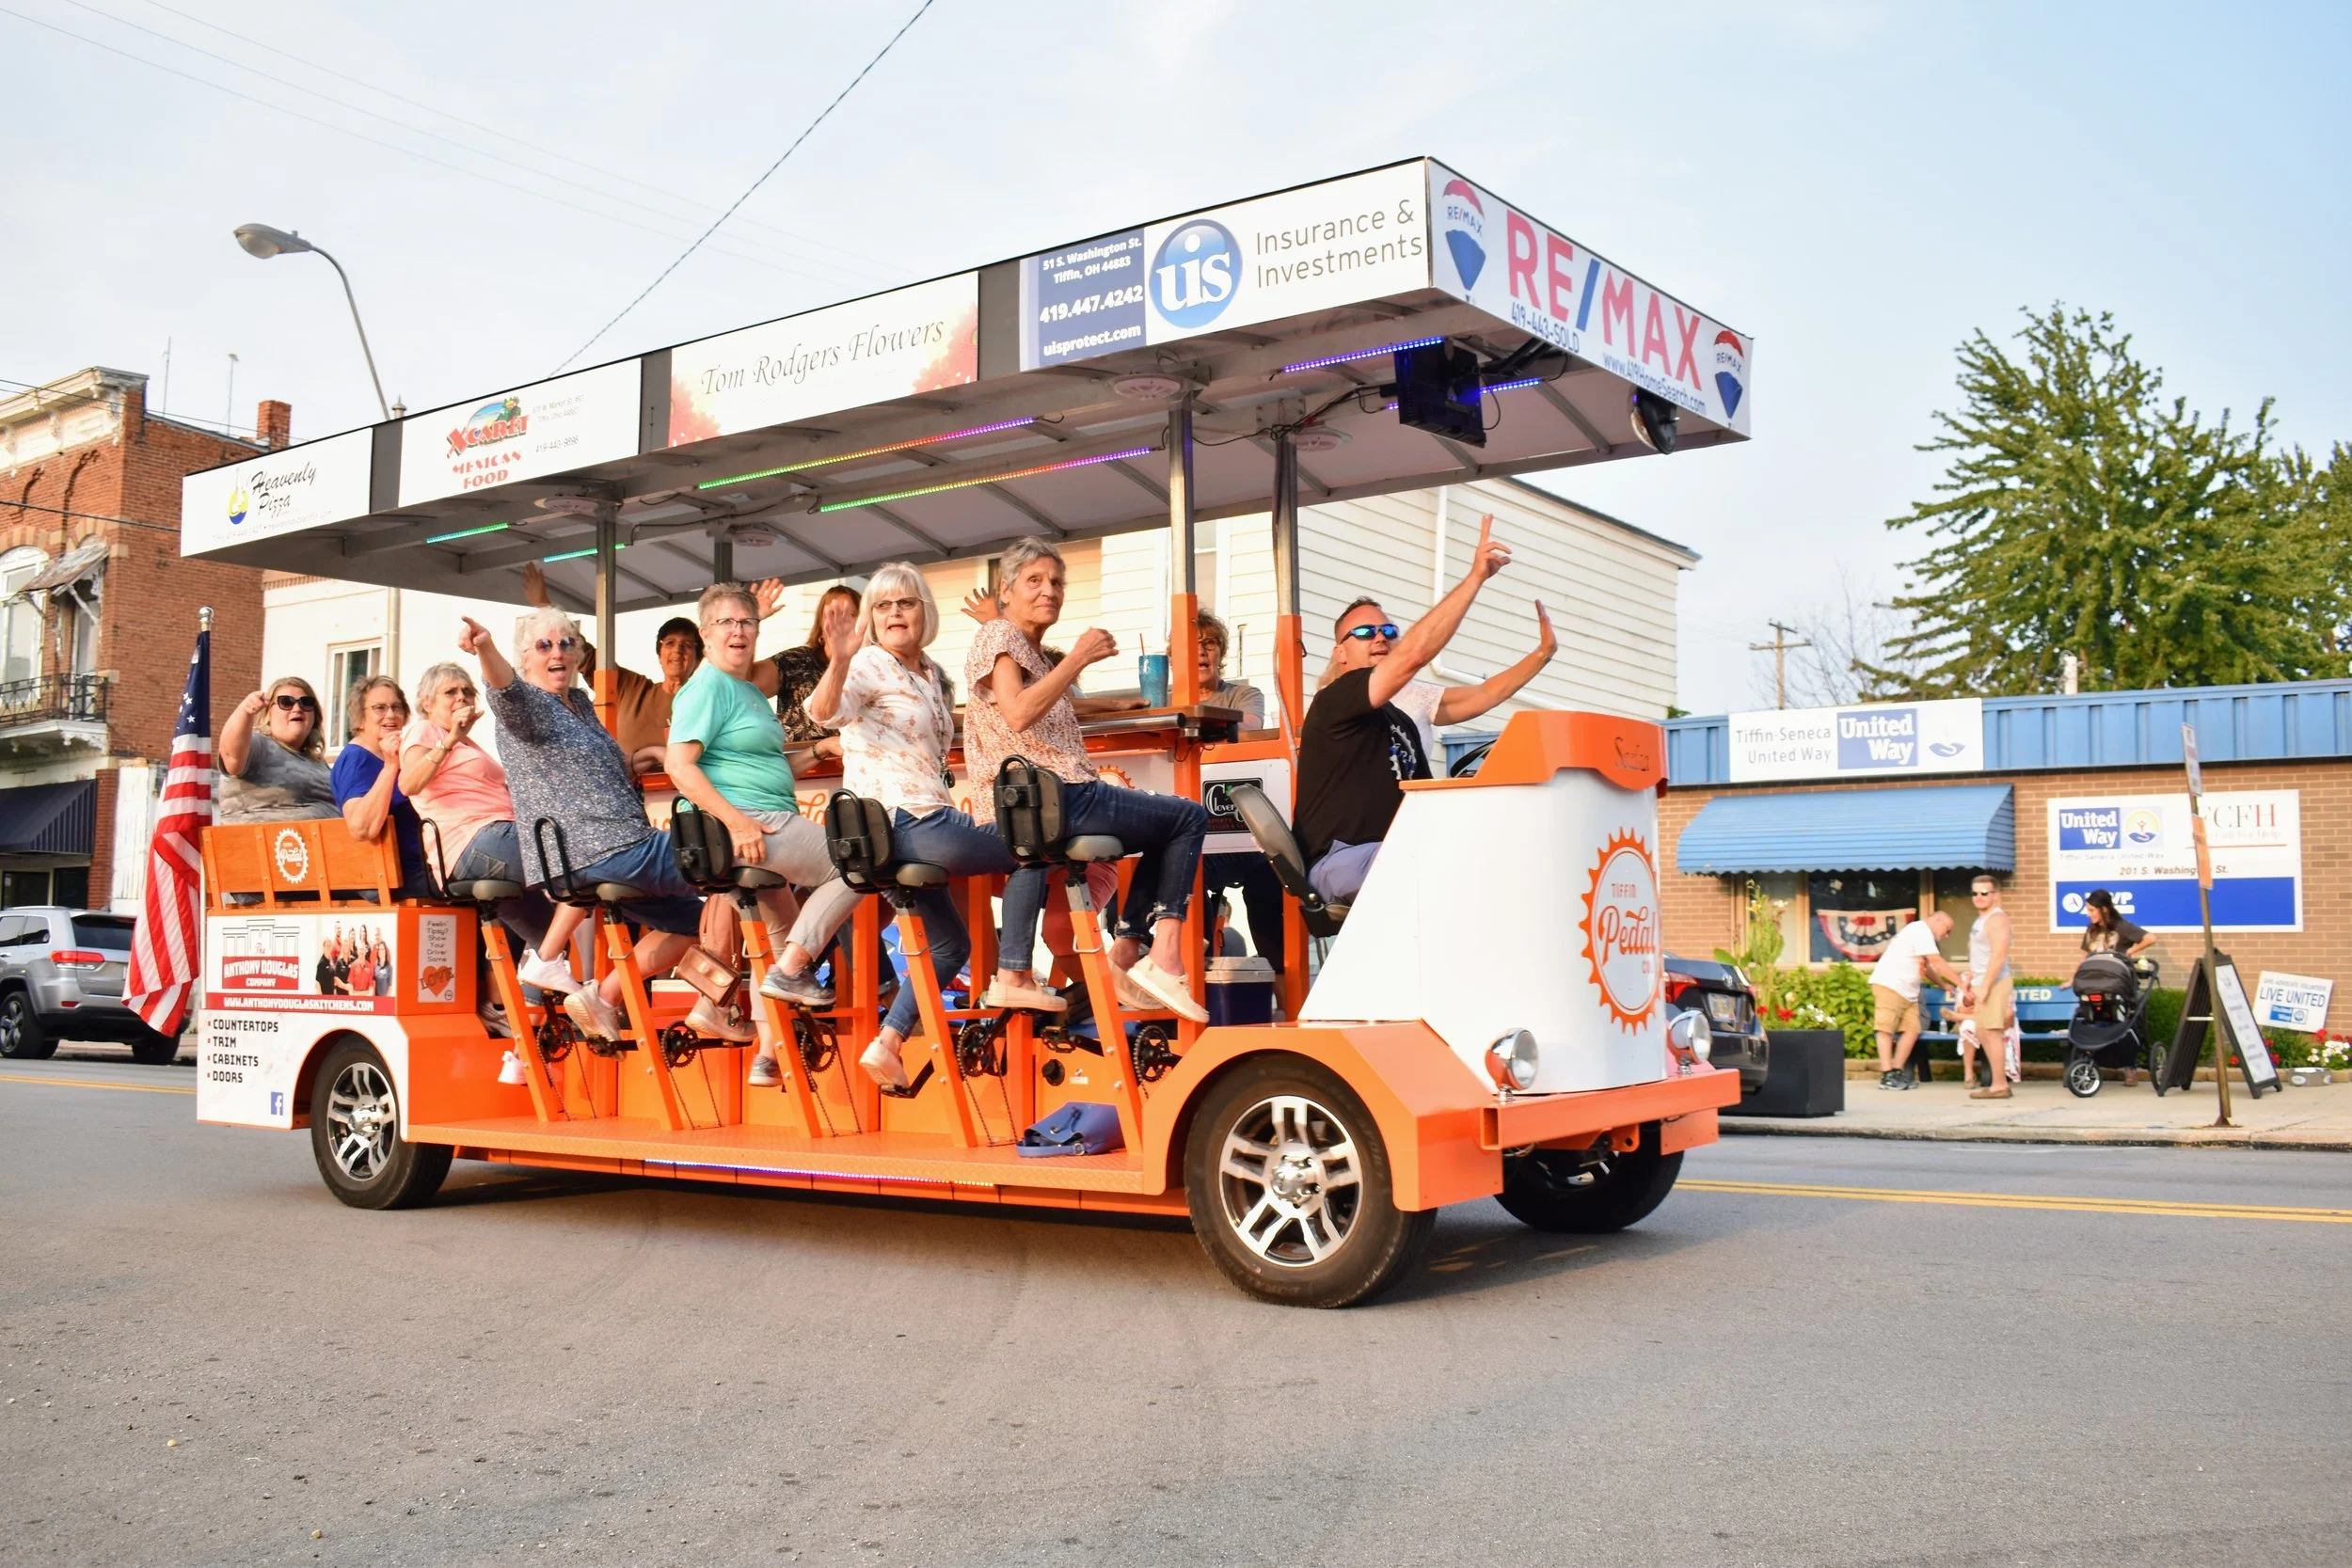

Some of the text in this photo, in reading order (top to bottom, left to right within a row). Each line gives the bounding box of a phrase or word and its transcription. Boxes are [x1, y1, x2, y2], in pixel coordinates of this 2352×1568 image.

[1256, 198, 1415, 256] Insurance &
[1447, 206, 1483, 238] RE/MAX
[1042, 236, 1143, 272] 51 S. Washington St.
[1257, 233, 1423, 289] Investments
[1053, 256, 1132, 285] Tiffin, OH 44883
[1155, 233, 1233, 312] uis
[1040, 284, 1144, 325] 419.447.4242
[1506, 209, 1703, 392] RE/MAX
[1042, 323, 1142, 357] uisprotect.com
[1511, 302, 1581, 354] 419-443-SOLD
[700, 319, 945, 395] Tom Rodgers Flowers
[1716, 352, 1741, 374] RE/MAX
[453, 451, 521, 475] MEXICAN
[250, 461, 317, 495] Heavenly
[463, 469, 509, 490] FOOD
[258, 492, 291, 518] Pizza
[1839, 714, 1915, 738] United
[1748, 748, 1832, 764] United Way
[1867, 738, 1915, 766] Way
[1205, 784, 1235, 816] Clover
[2060, 811, 2118, 830] United
[2083, 829, 2119, 848] Way
[2120, 864, 2229, 877] 201 S. Washing St.
[1611, 882, 1636, 898] TIFFIN
[1598, 905, 1656, 968] Pedal
[224, 959, 298, 979] ANTHONY DOUGLAS
[246, 977, 276, 987] COMPANY
[2259, 987, 2326, 1007] LIVE UNITED
[213, 1019, 279, 1033] COUNTERTOPS
[213, 1036, 236, 1048] TRIM
[213, 1053, 259, 1067] CABINETS
[213, 1070, 243, 1084] DOORS
